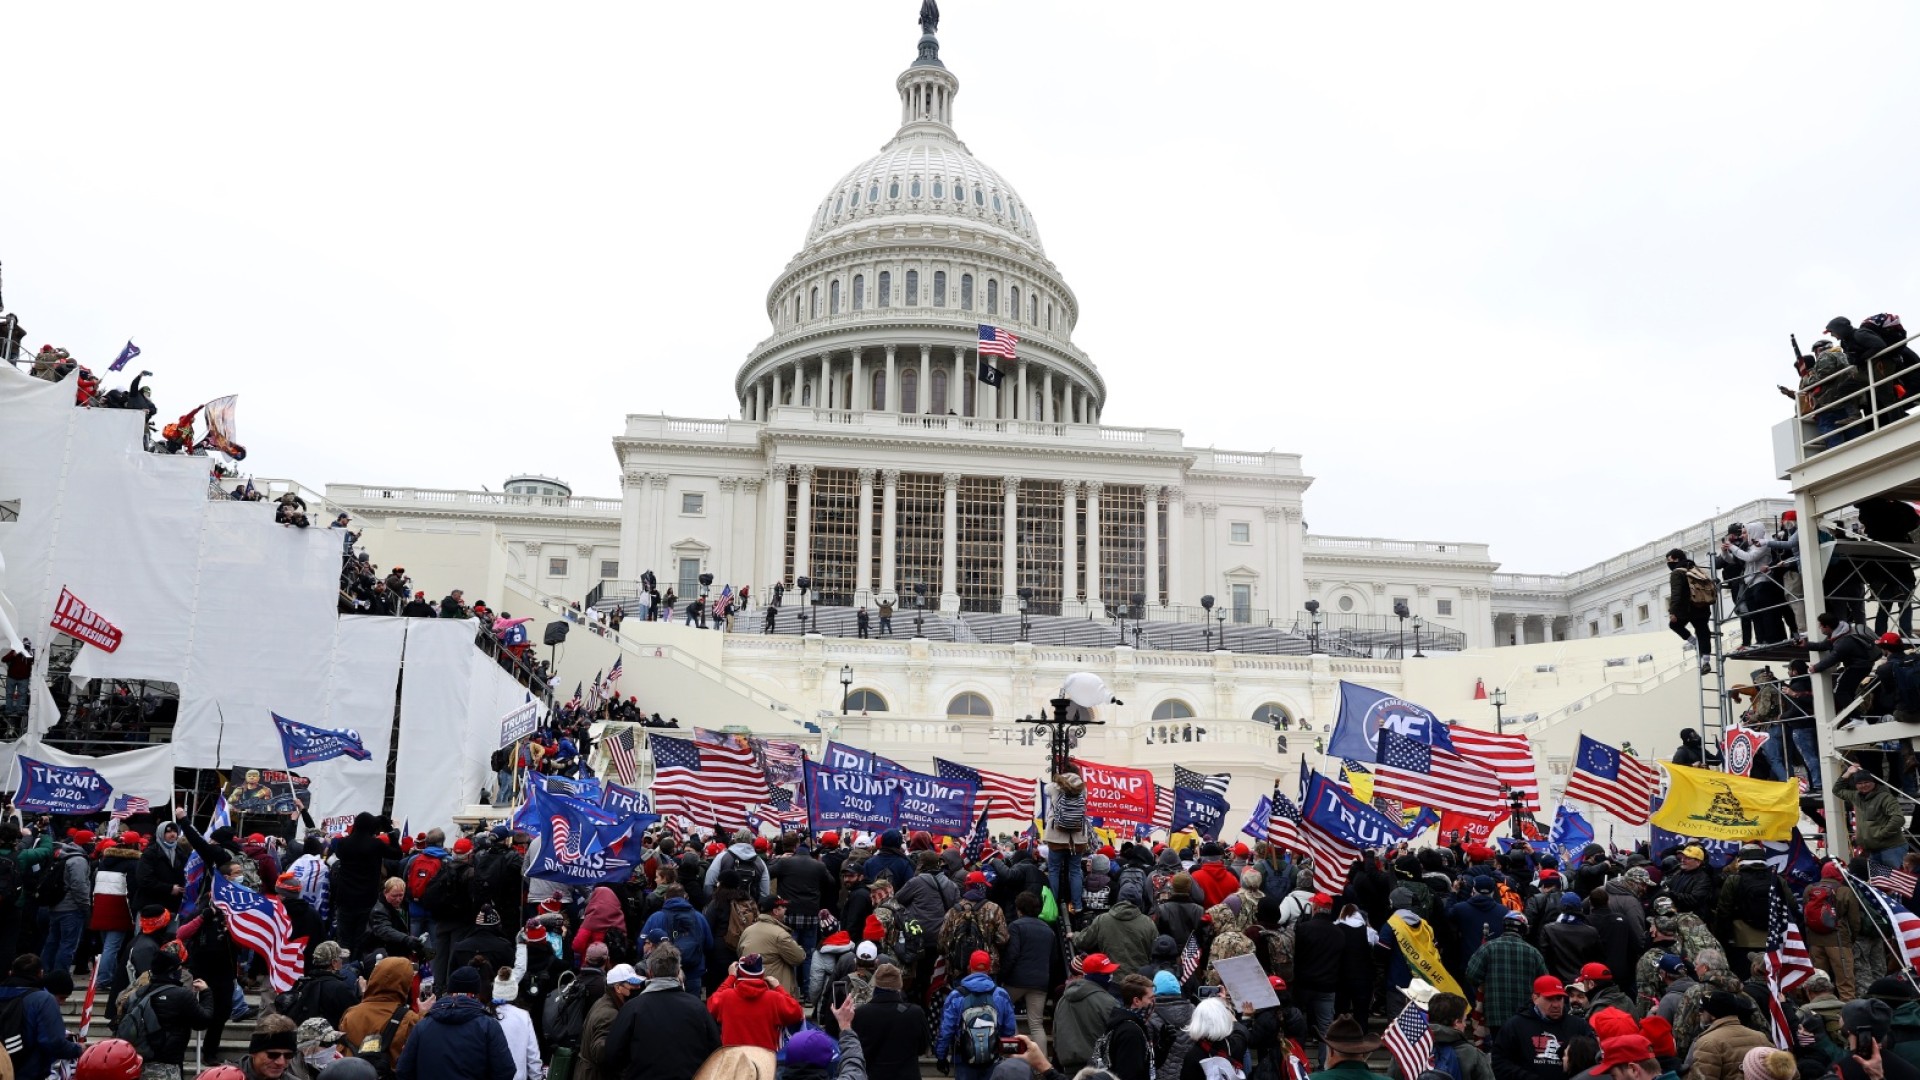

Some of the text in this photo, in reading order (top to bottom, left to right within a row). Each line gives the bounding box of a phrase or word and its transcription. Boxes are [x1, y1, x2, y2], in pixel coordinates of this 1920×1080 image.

[60, 617, 76, 630] MY
[74, 623, 117, 649] PRESIDENT
[502, 707, 536, 732] TRUMP
[31, 766, 100, 791] TRUMP
[817, 771, 898, 797] TRUMP
[1081, 766, 1143, 793] RUMP
[1086, 800, 1118, 809] AMERICA
[821, 811, 840, 820] KEEP
[899, 812, 933, 823] AMERICA
[1706, 825, 1738, 835] TREAD
[567, 865, 607, 878] TRUMP
